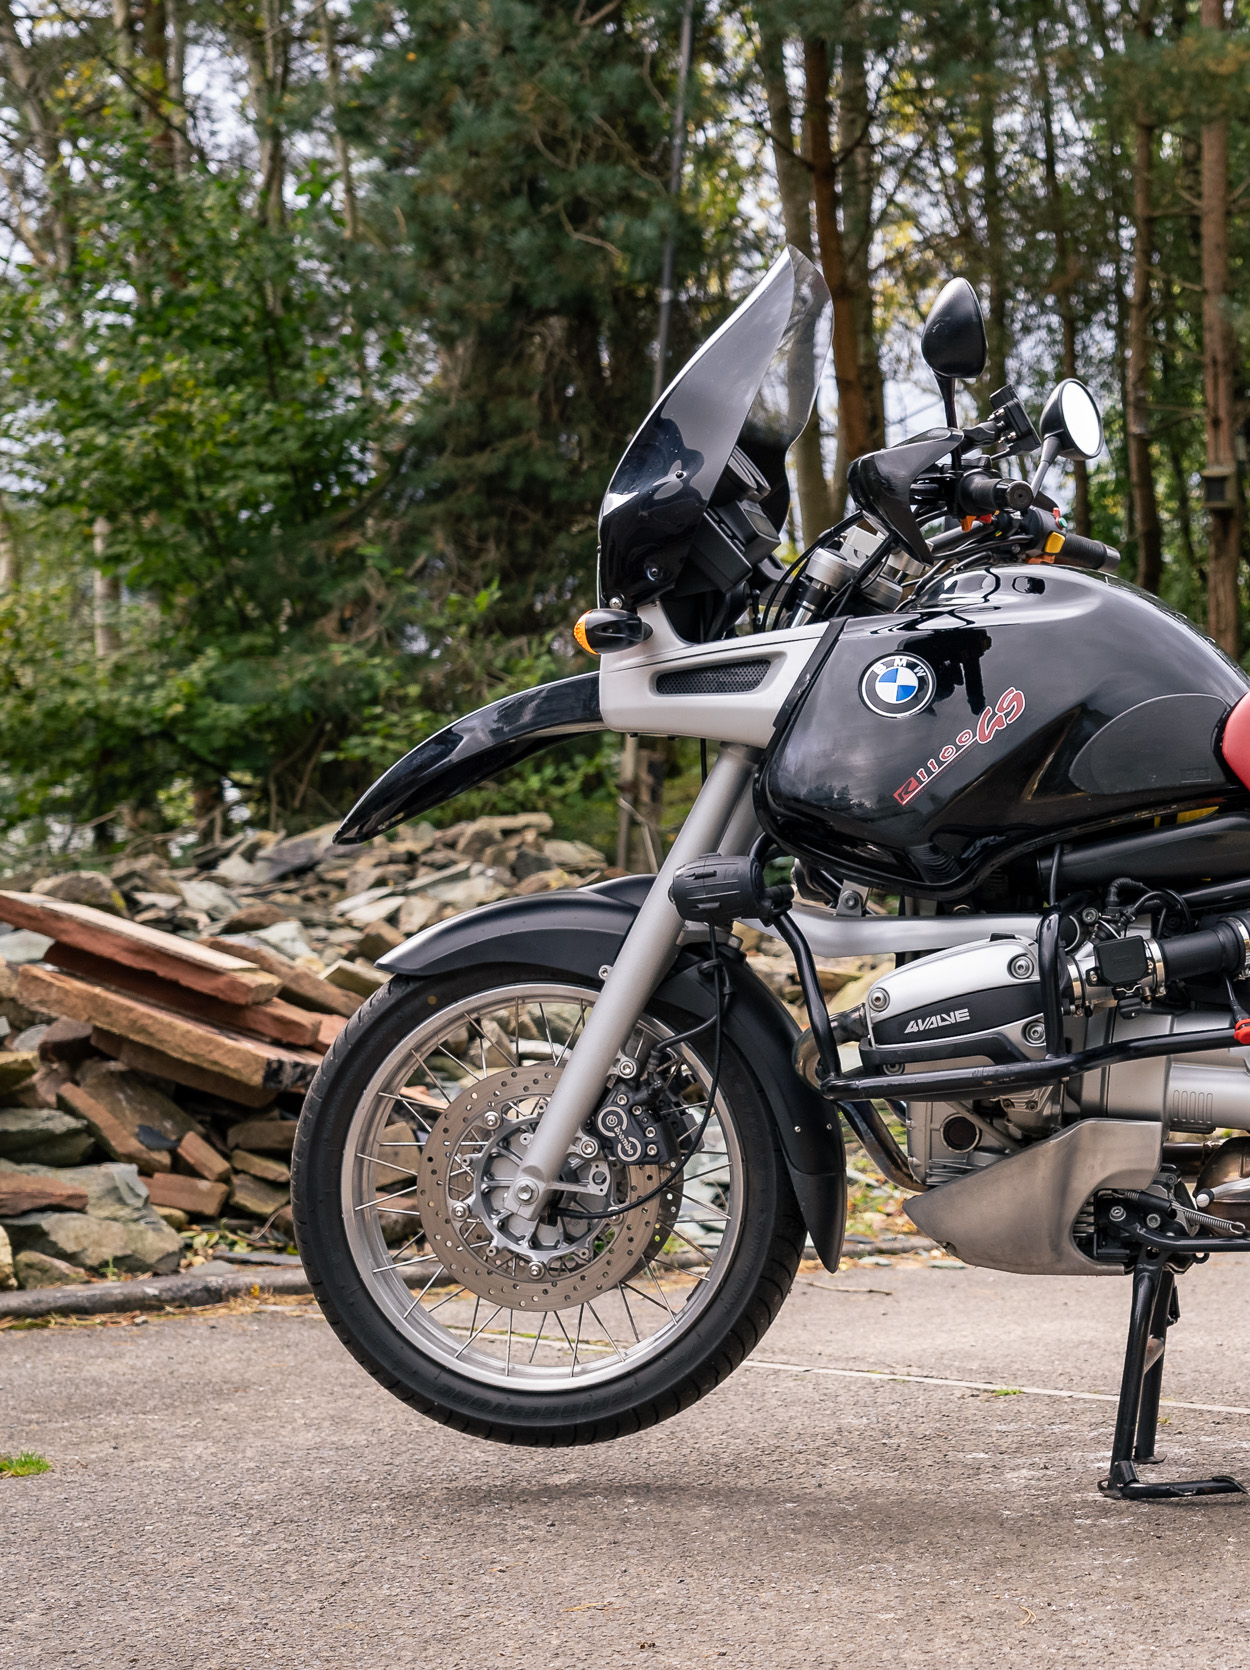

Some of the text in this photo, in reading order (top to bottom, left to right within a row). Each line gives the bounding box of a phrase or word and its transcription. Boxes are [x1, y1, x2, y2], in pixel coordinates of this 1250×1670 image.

[873, 658, 926, 678] BMW
[904, 1008, 970, 1034] 4VALVE
[614, 1125, 634, 1155] brembo
[433, 1383, 634, 1419] BRIDGESTONE
